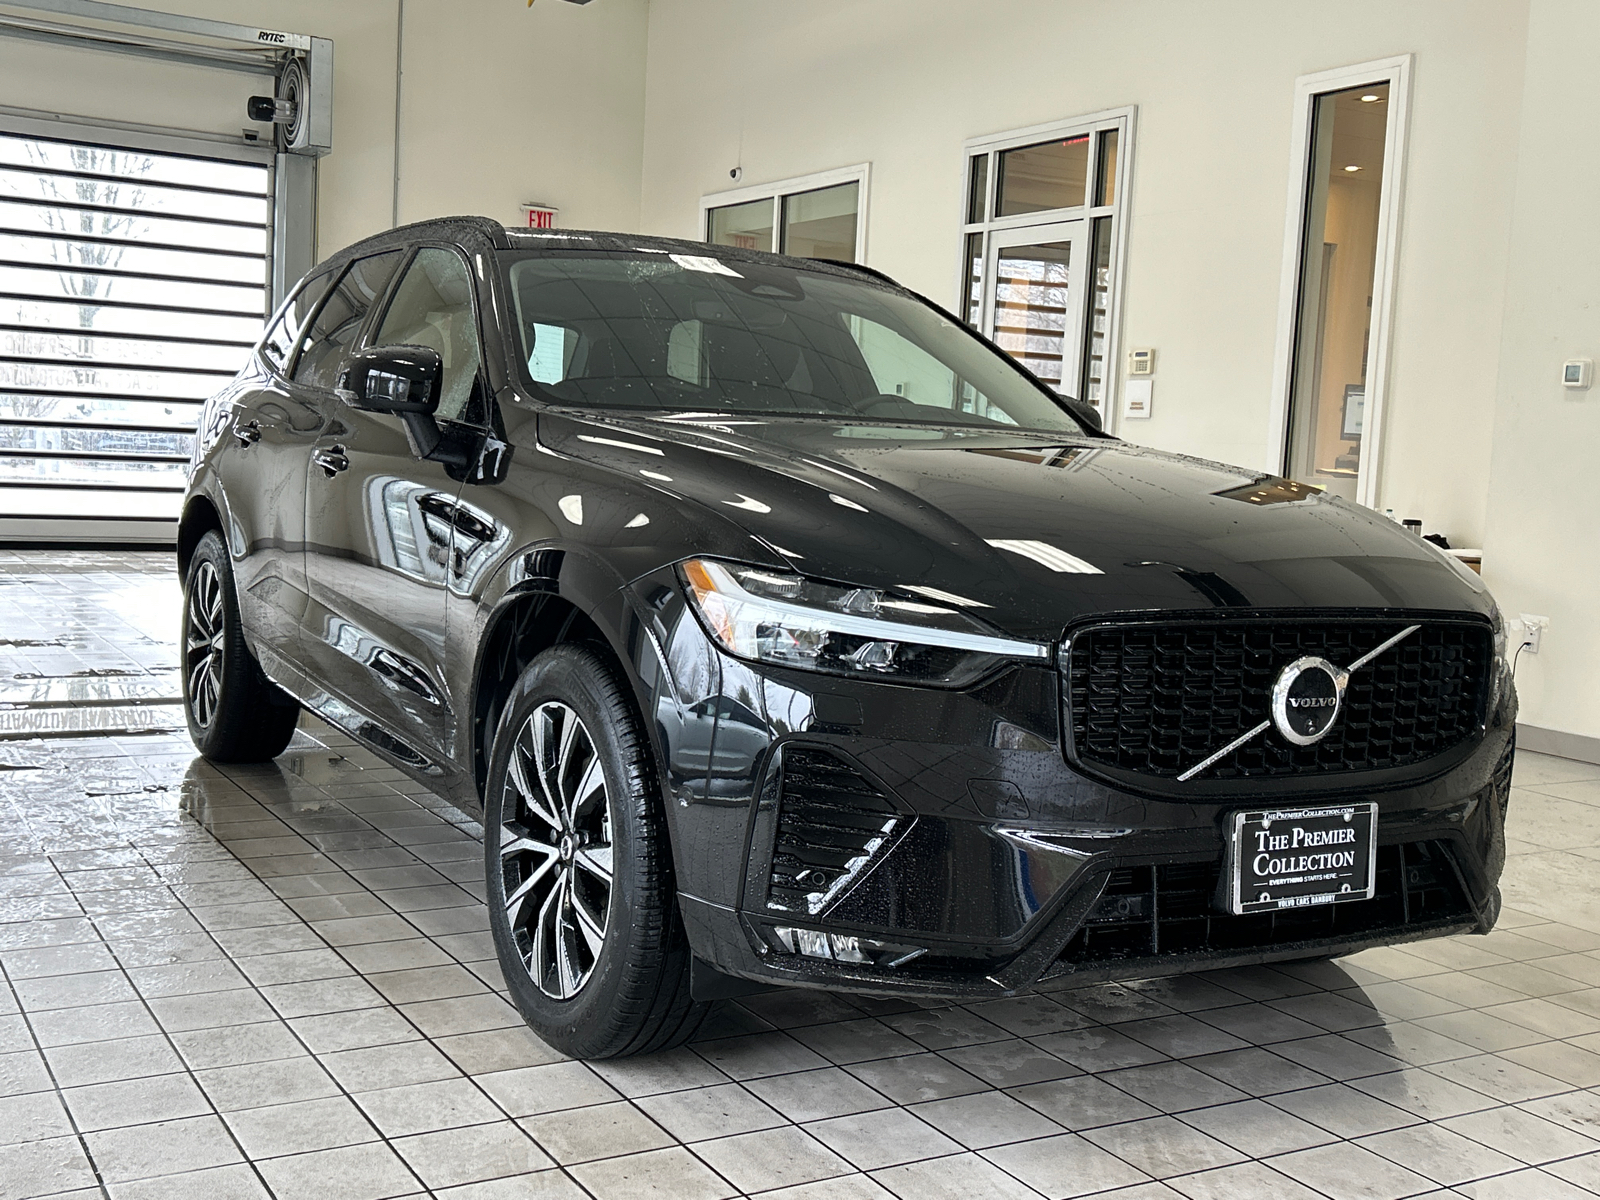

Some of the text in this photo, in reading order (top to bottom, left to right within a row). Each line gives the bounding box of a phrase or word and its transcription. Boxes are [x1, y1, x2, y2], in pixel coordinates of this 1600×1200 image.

[258, 31, 286, 43] RYTEC
[528, 209, 554, 228] EXIT
[1288, 696, 1336, 708] VOLVO
[1255, 827, 1356, 852] THE PREMIER
[1253, 851, 1356, 876] COLLECTION
[1269, 876, 1304, 886] EVERYTHING
[1304, 874, 1323, 883] STARTS
[1277, 894, 1336, 908] VOLVO CARS DANBURY
